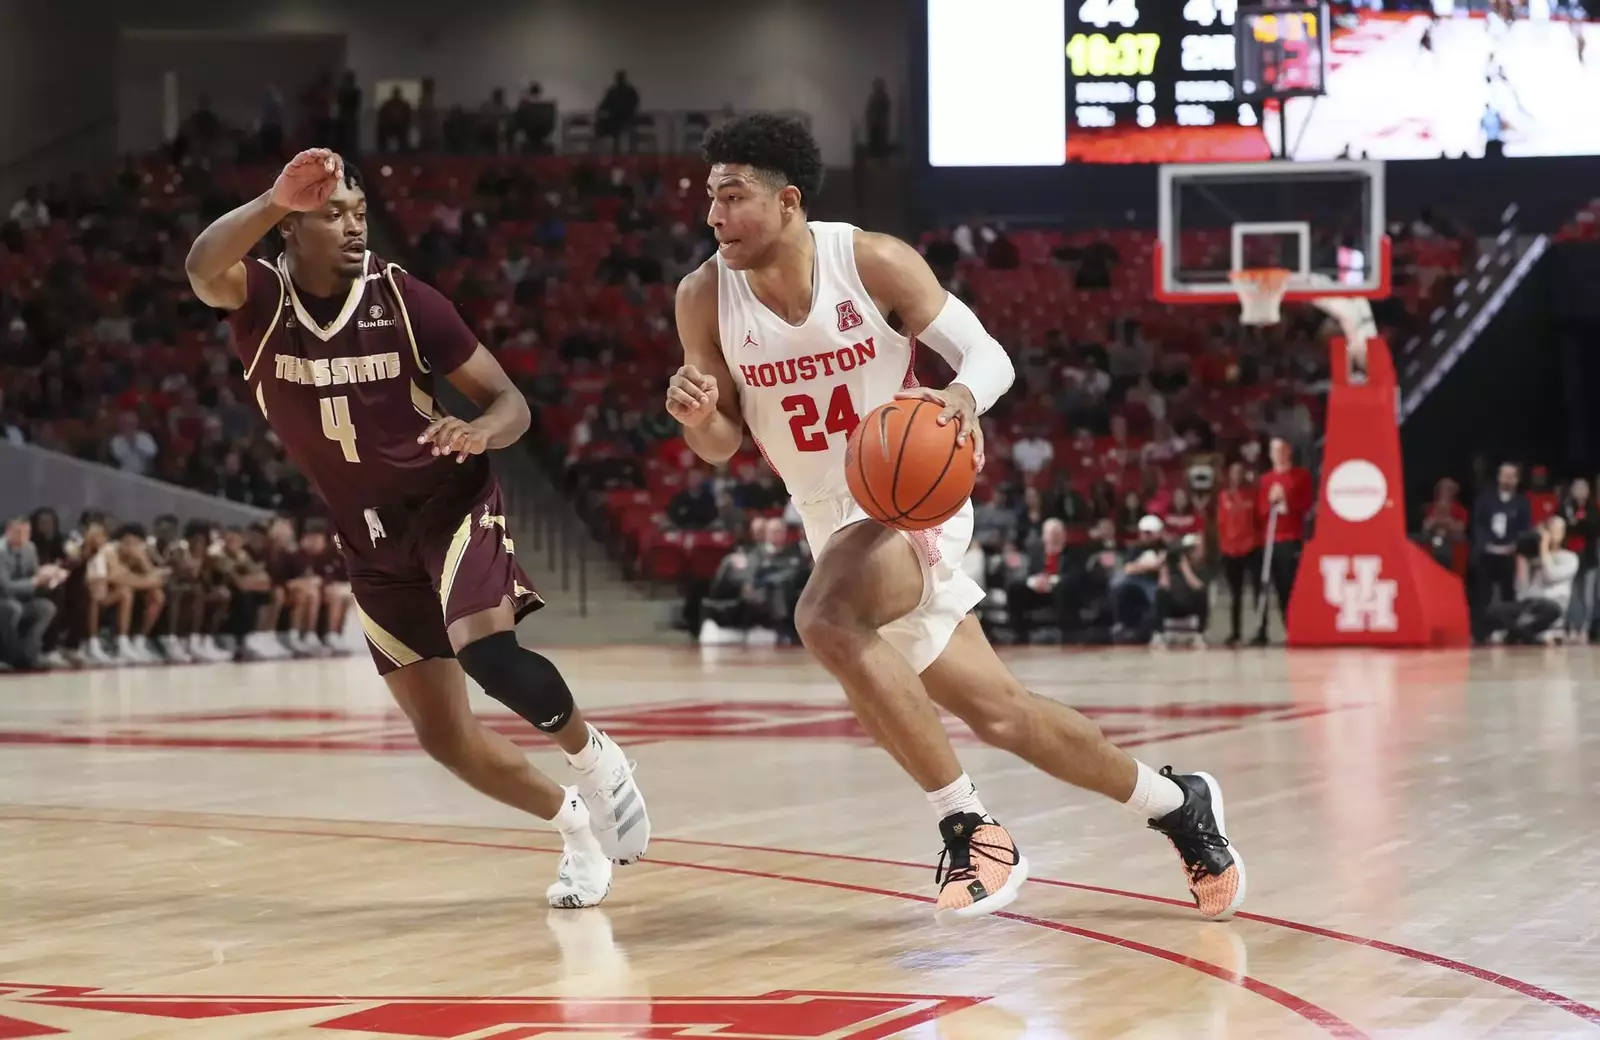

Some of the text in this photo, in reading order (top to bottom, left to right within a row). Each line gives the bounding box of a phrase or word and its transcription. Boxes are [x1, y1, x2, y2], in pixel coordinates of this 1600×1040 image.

[331, 352, 400, 385] STATE
[739, 336, 876, 387] HOUSTON
[319, 395, 361, 463] 4
[781, 383, 860, 452] 24
[1319, 555, 1398, 632] UH
